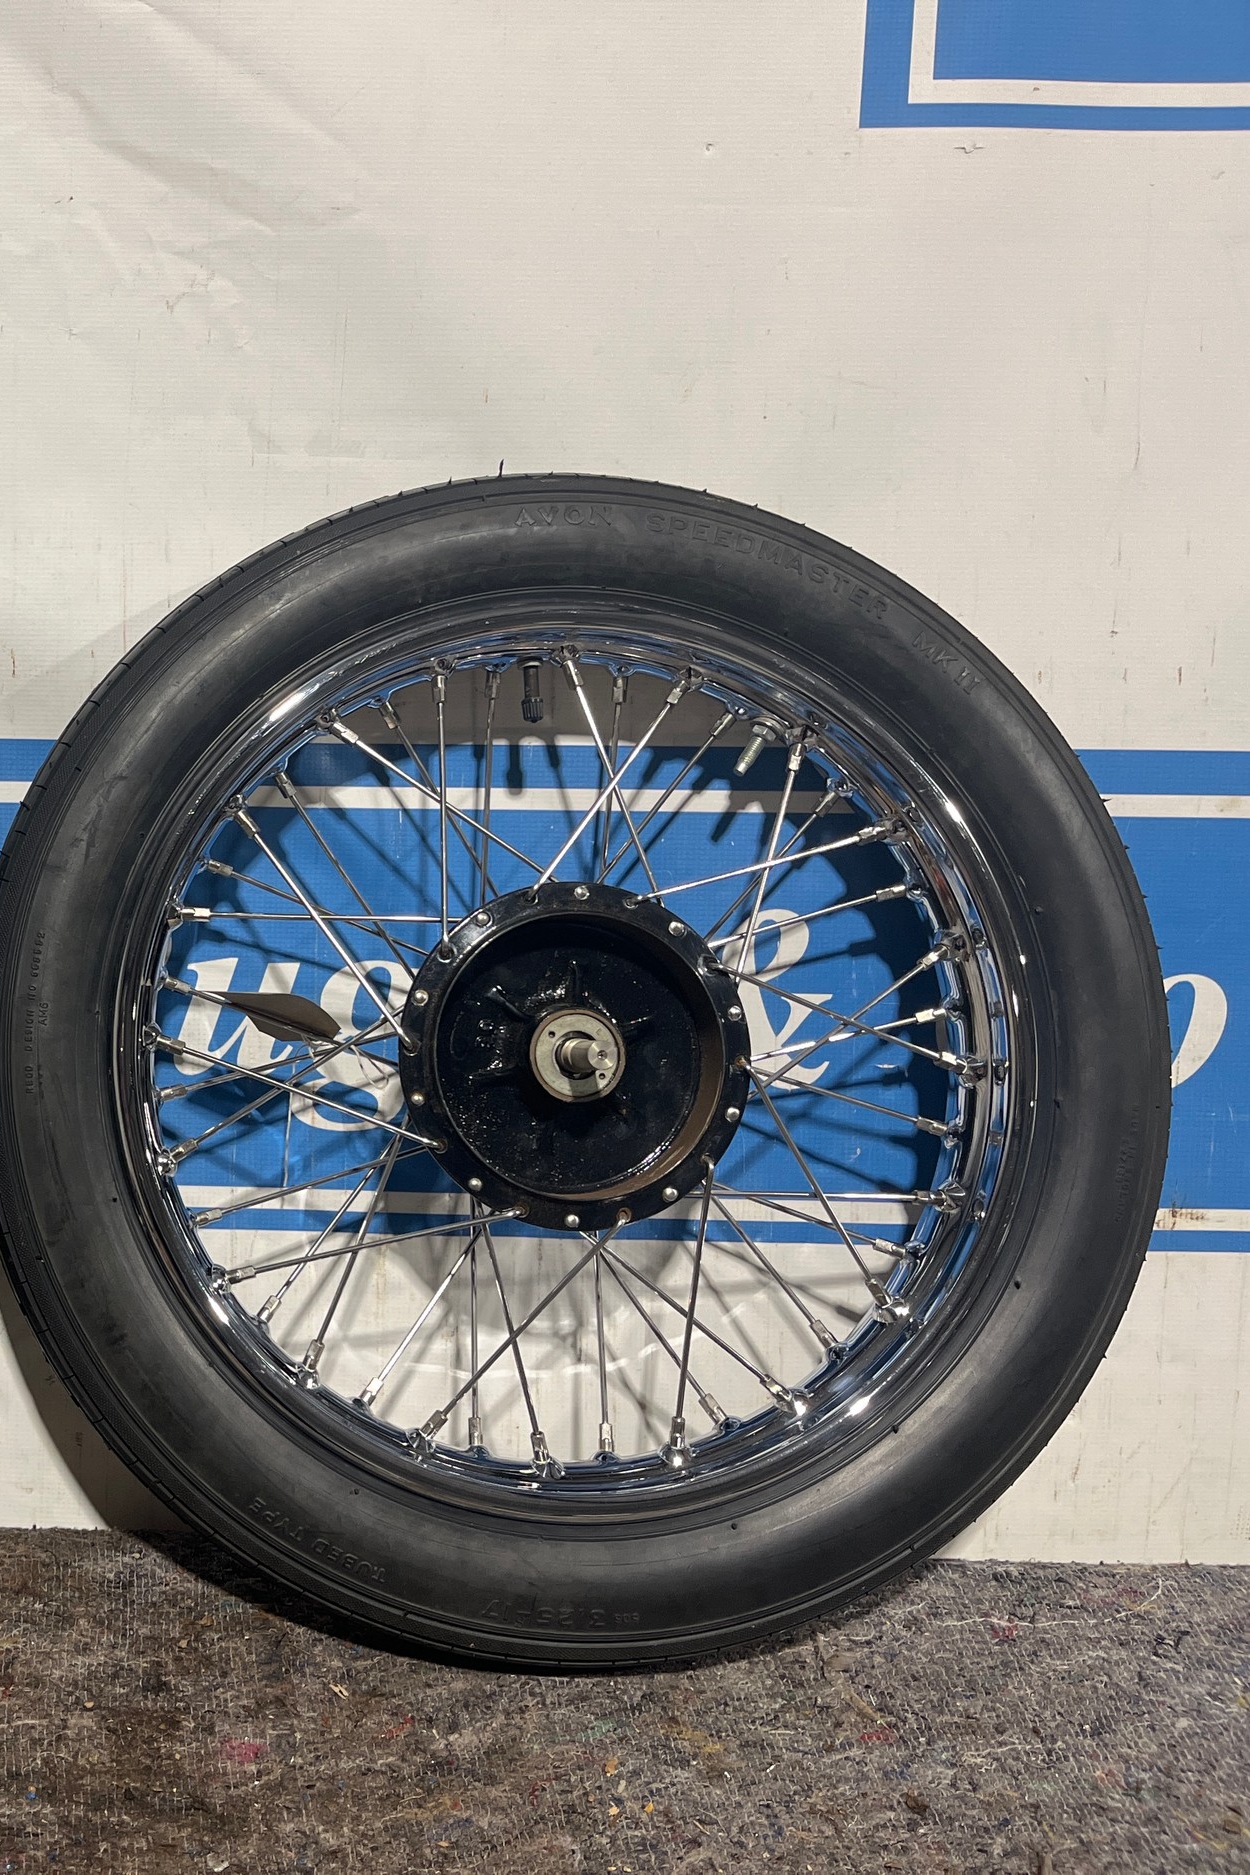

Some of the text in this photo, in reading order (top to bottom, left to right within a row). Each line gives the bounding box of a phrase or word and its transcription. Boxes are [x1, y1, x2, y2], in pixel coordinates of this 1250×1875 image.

[515, 504, 613, 528] AVON
[646, 513, 889, 620] SPEEDMASTER
[249, 1497, 386, 1583] TUBED TYPE
